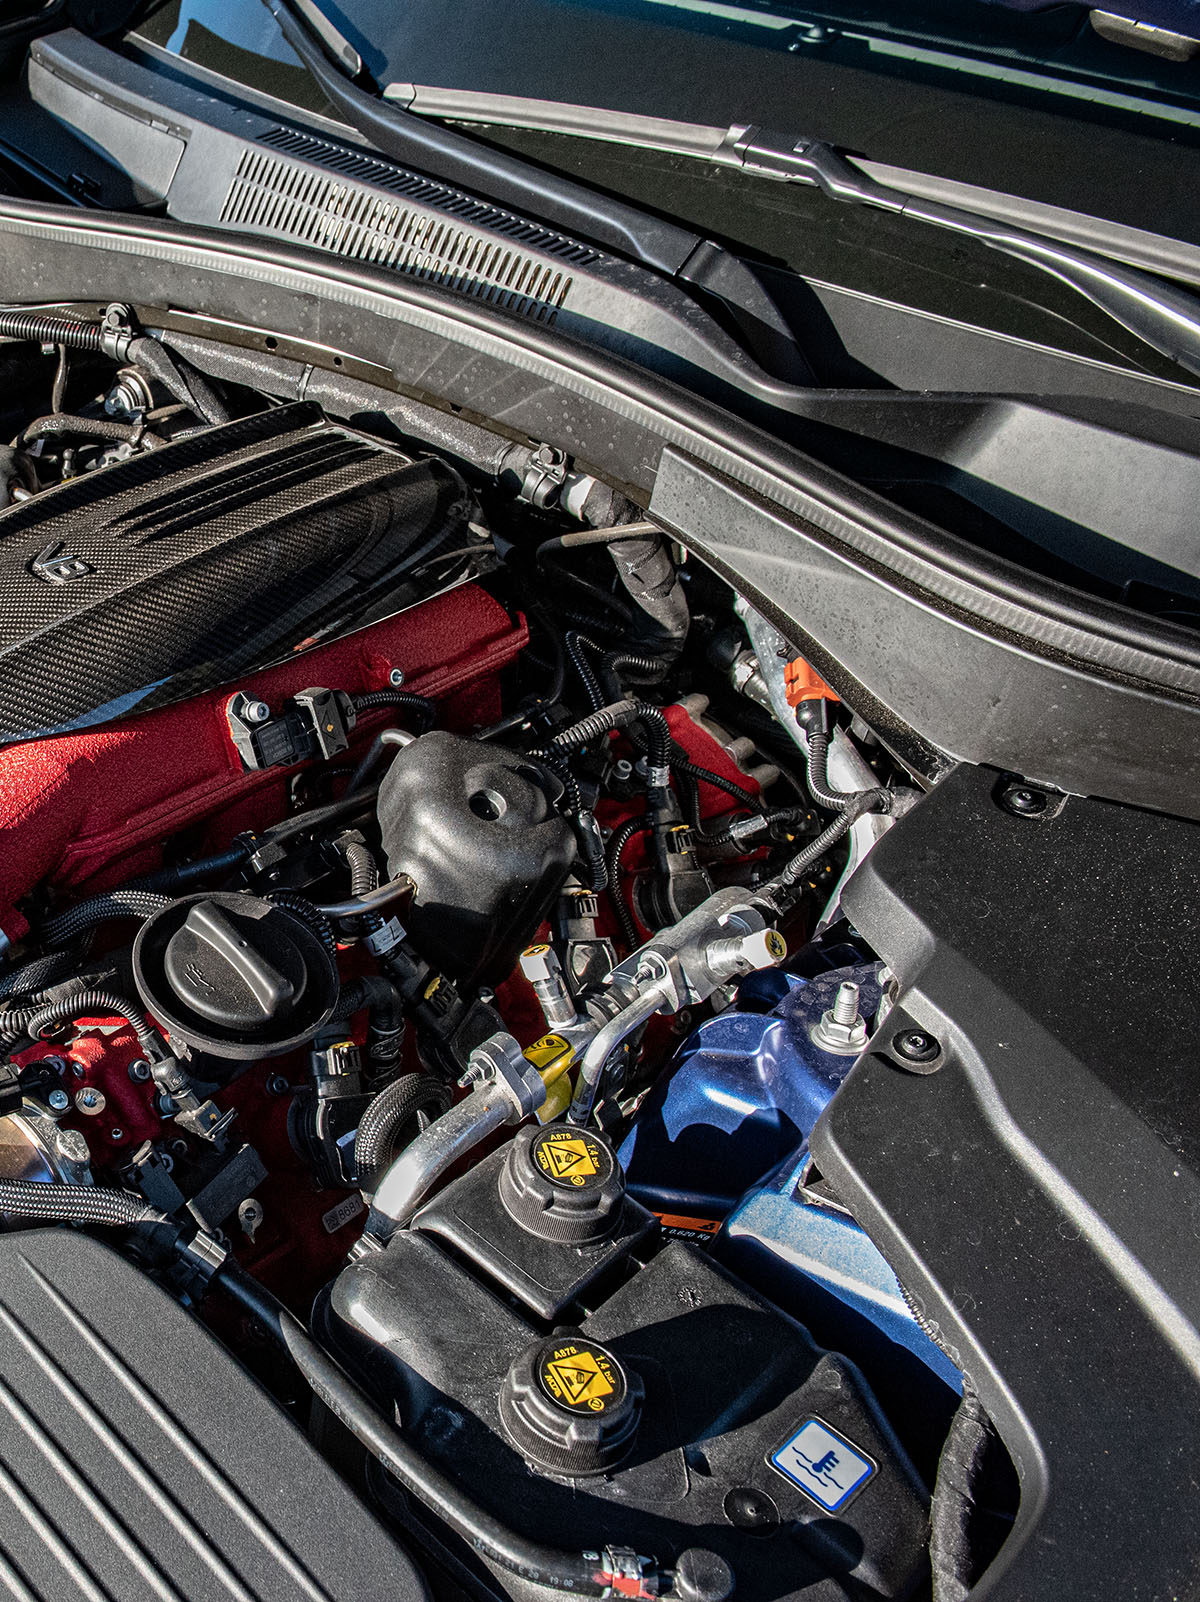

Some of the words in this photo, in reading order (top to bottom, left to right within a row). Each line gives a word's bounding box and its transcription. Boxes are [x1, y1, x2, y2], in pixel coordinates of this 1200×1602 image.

[32, 540, 90, 584] V8
[550, 1133, 572, 1141] A878
[553, 1346, 577, 1360] A878
[595, 1355, 611, 1371] 1.4
[604, 1369, 616, 1385] bar
